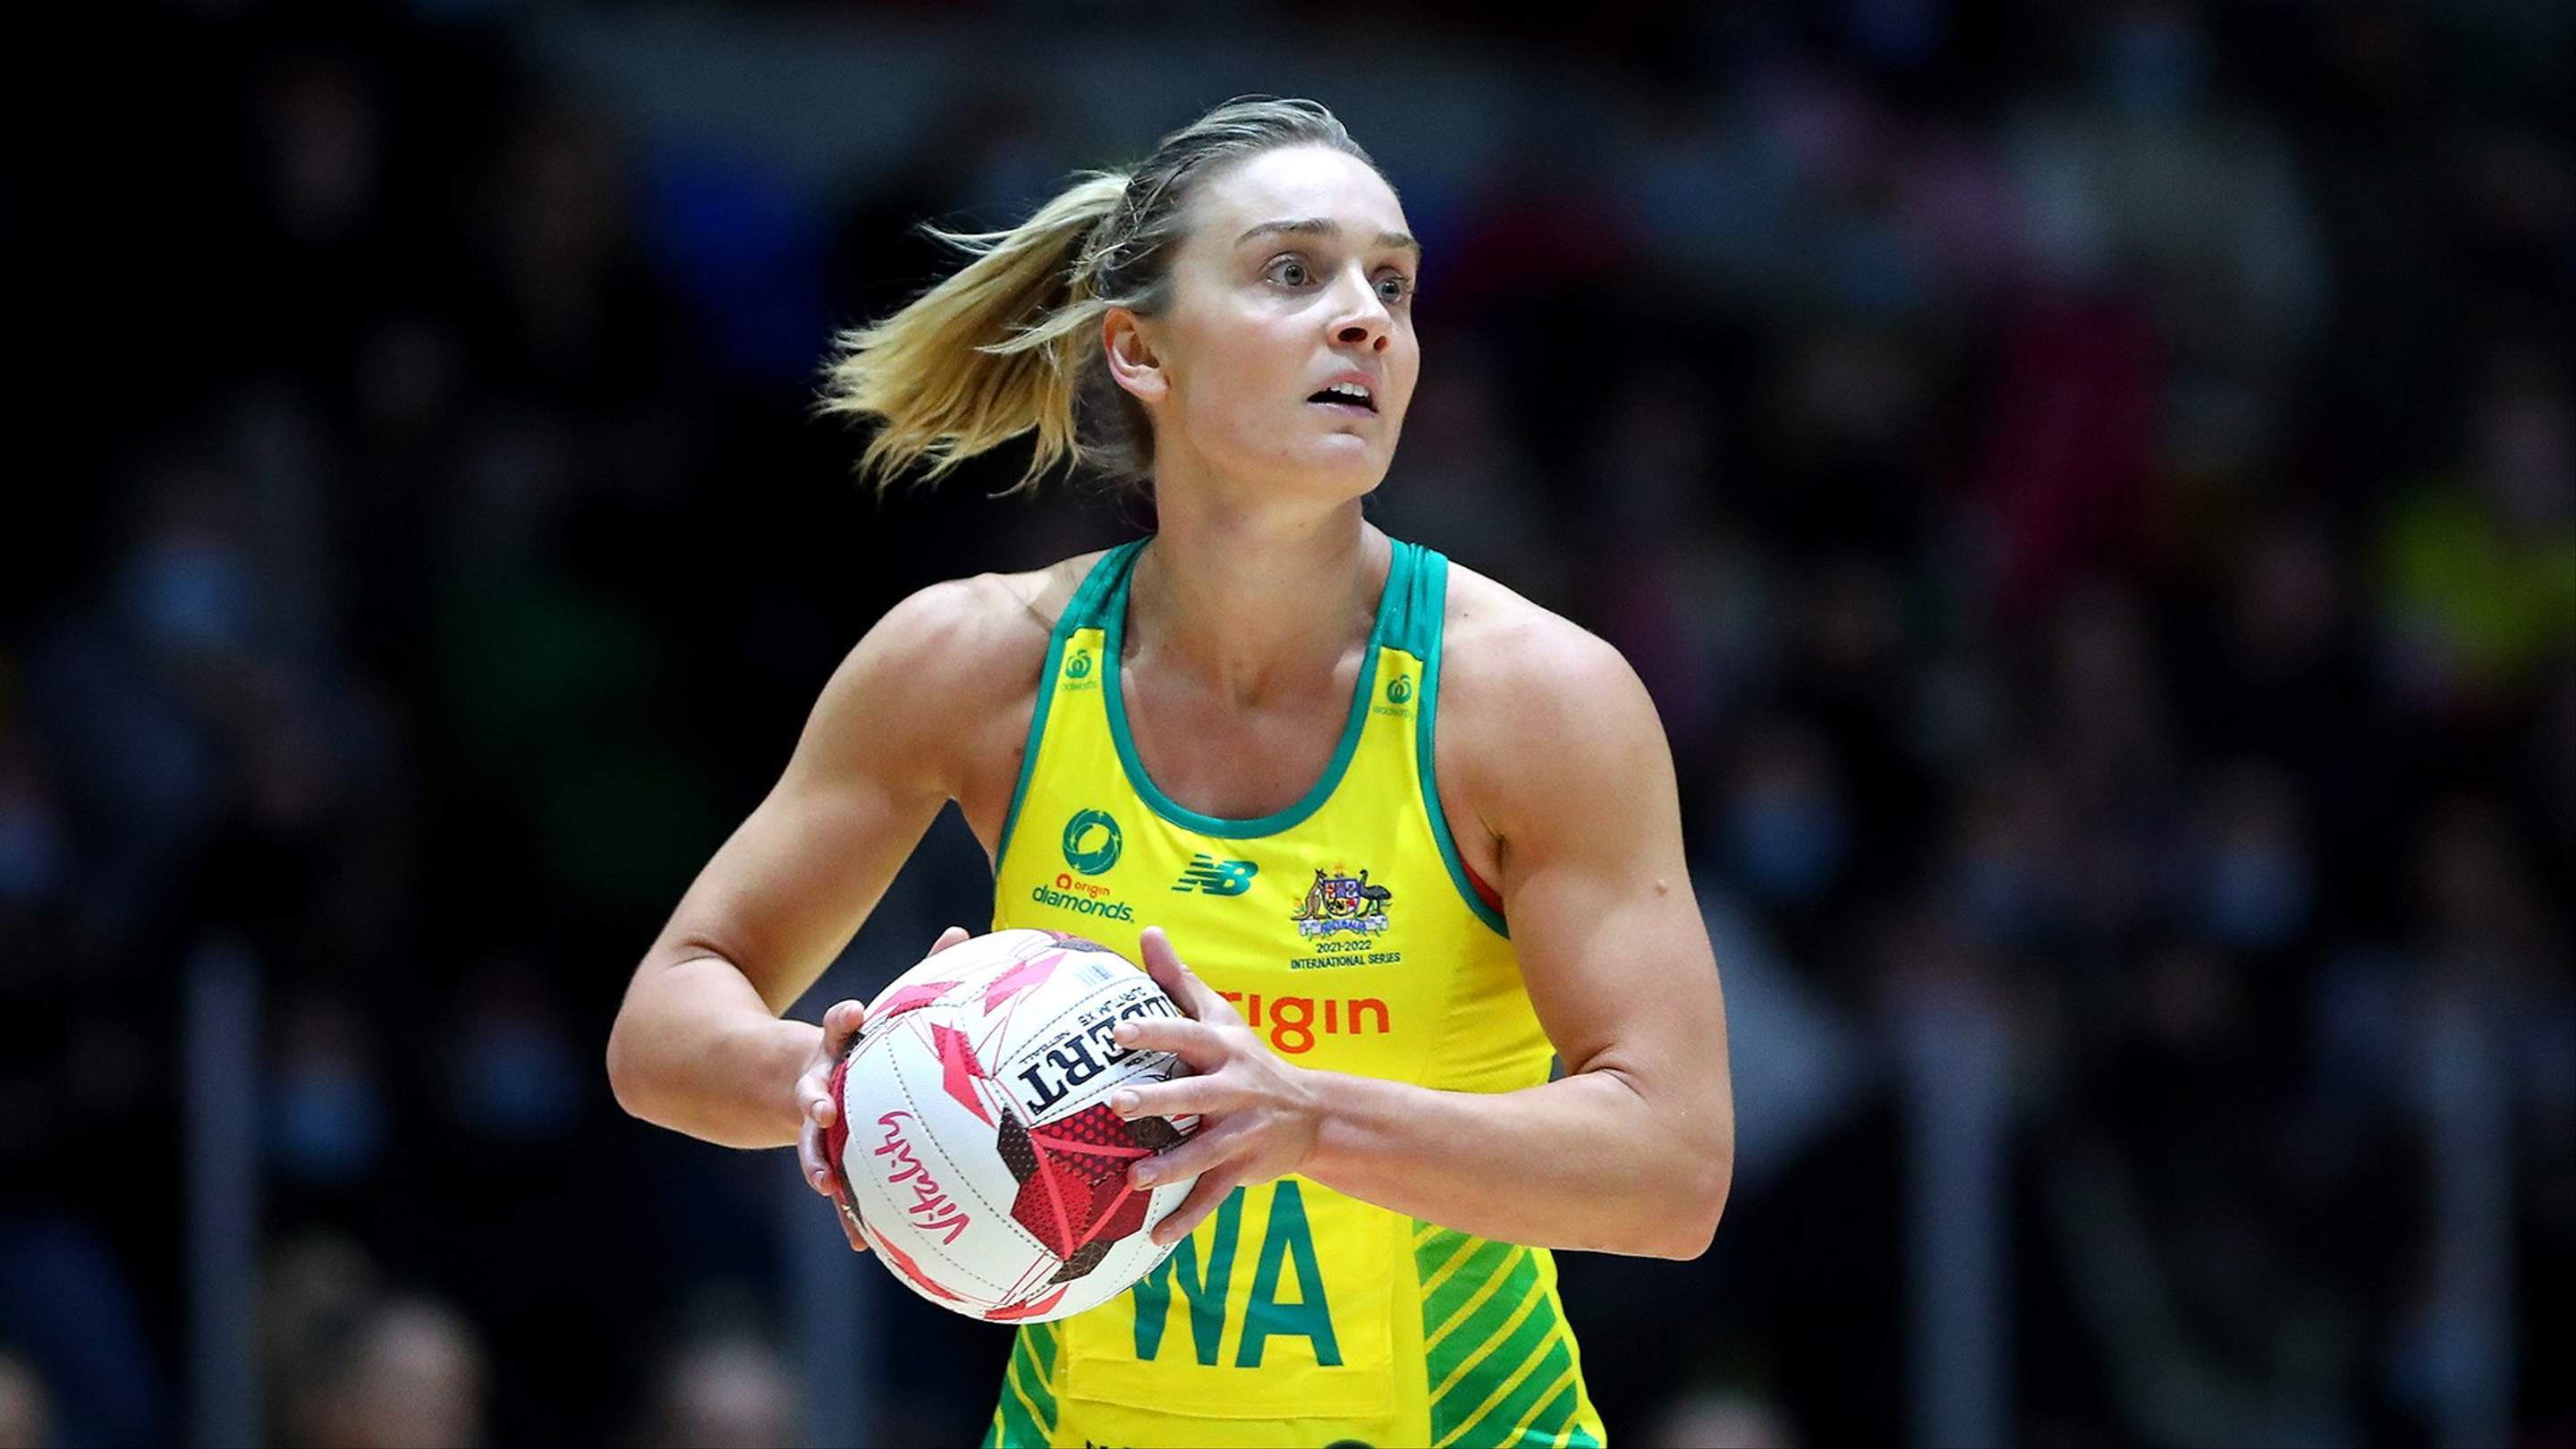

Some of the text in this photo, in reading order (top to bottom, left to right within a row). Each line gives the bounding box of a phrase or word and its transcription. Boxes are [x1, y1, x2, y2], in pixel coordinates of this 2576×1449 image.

[1291, 952, 1401, 969] INTERNATIONAL SERIES
[1316, 940, 1372, 953] 2021-2022
[1216, 990, 1390, 1054] igin
[875, 1111, 970, 1246] Vitality
[1131, 1180, 1344, 1368] WA
